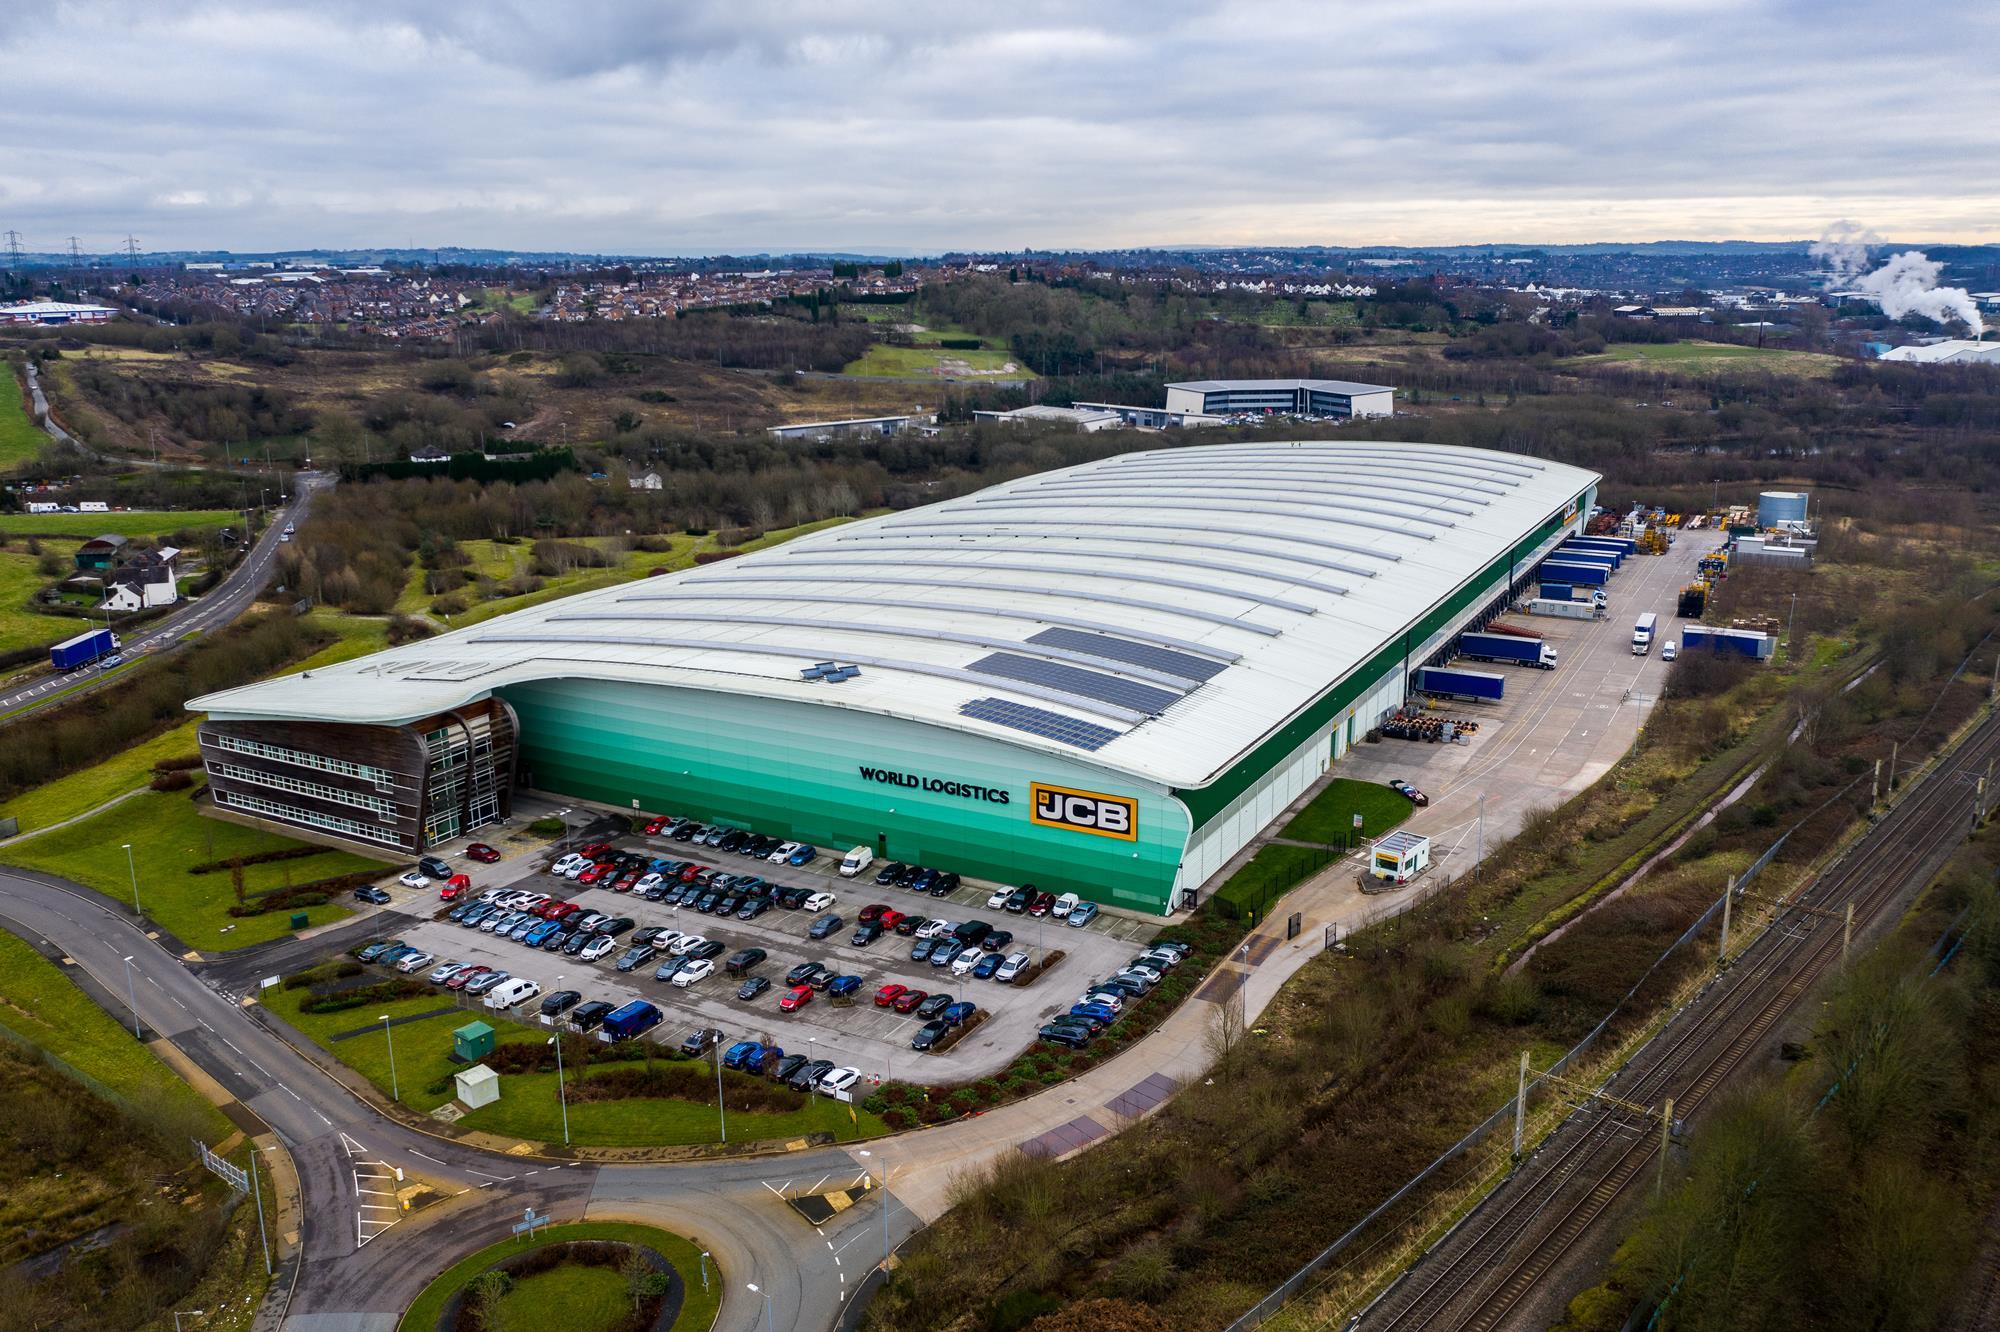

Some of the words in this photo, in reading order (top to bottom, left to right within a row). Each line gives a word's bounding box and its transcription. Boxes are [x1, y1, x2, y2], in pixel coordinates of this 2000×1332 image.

[859, 766, 919, 788] WORLD
[922, 777, 1010, 804] LOGISTICS
[1038, 793, 1129, 831] JCB
